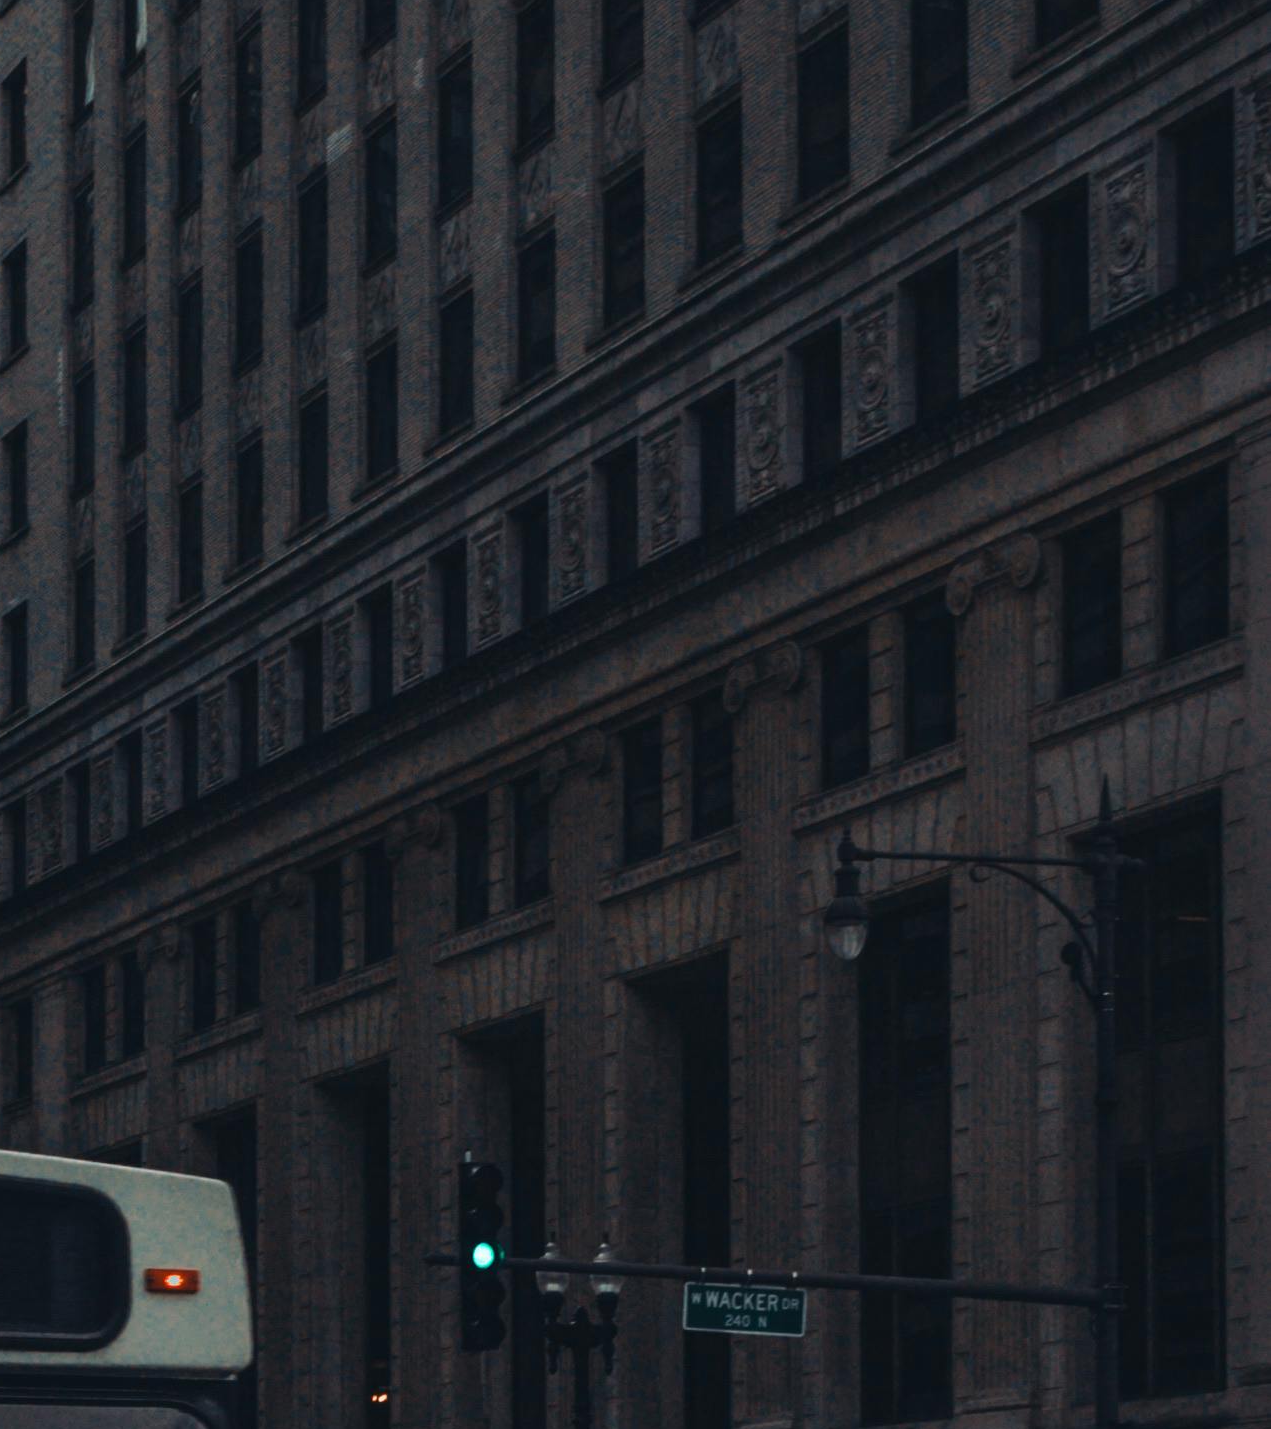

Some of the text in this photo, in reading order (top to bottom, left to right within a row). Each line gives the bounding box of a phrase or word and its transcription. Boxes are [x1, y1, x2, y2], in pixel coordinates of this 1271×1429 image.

[691, 1290, 800, 1312] W WACKER DR
[724, 1314, 767, 1328] 240 N
